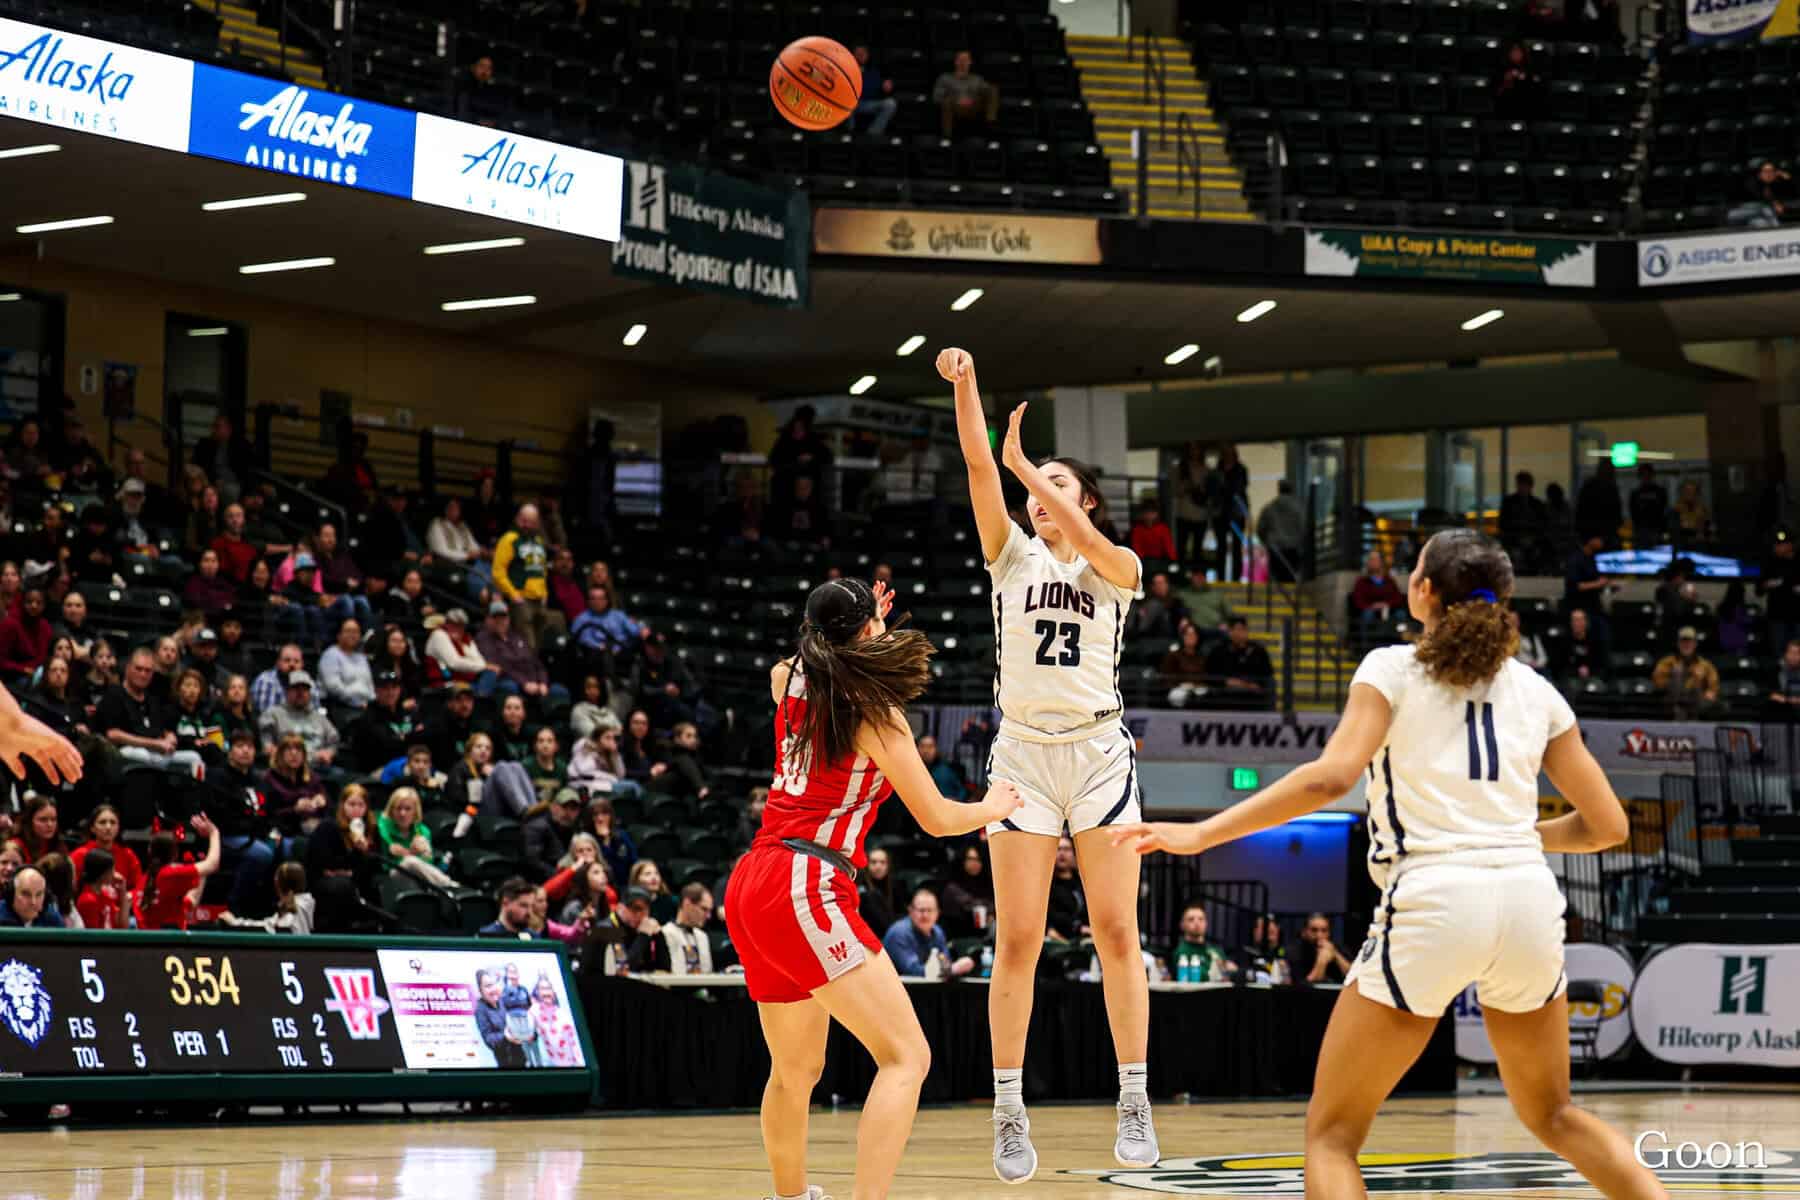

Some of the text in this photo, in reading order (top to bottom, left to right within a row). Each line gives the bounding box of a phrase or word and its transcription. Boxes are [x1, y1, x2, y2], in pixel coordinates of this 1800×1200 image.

[0, 33, 134, 104] Alaska
[0, 96, 119, 133] AIRLINES
[239, 86, 373, 159] Alaska
[246, 145, 357, 185] AIRLINES
[461, 137, 575, 200] Alaska
[669, 192, 785, 240] Hilcorp Alaska
[612, 236, 667, 272] Proud
[668, 245, 733, 284] Sponsor
[734, 258, 752, 289] of
[1024, 582, 1094, 620] LIONS
[1034, 619, 1081, 667] 23
[1465, 701, 1499, 782] 11
[80, 958, 105, 1003] 5
[165, 955, 240, 1006] 3:54
[280, 961, 304, 1005] 5
[68, 1012, 140, 1039] FLS 2
[173, 1029, 231, 1056] PER 1
[272, 1013, 327, 1039] FLS 2
[1658, 1026, 1741, 1052] Hilcorp
[73, 1044, 147, 1069] TOL 5
[278, 1043, 334, 1068] TOL 5
